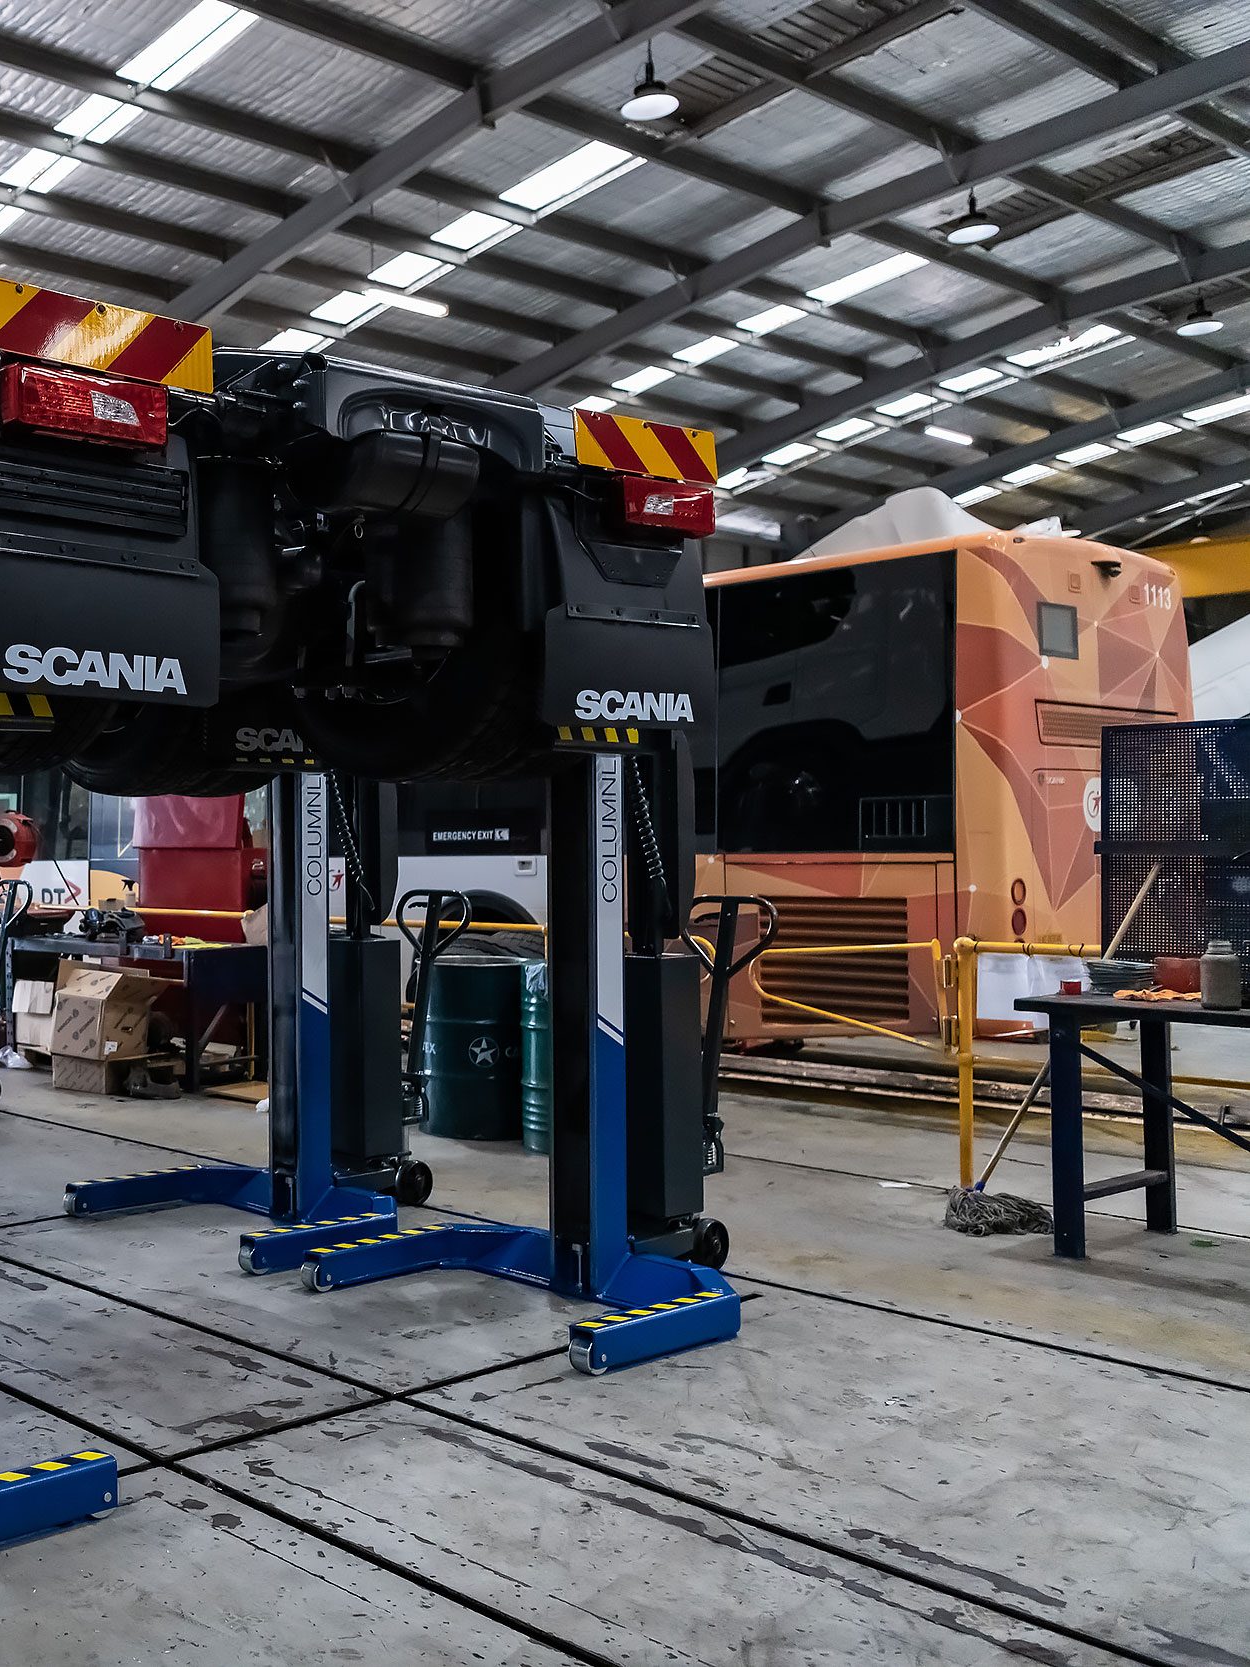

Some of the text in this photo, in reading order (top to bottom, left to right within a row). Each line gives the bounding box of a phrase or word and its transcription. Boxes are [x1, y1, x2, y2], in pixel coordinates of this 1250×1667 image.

[1144, 583, 1171, 610] 1113
[2, 644, 187, 695] SCANIA
[574, 689, 694, 722] SCANIA
[433, 830, 494, 841] EMERGENCY EXIT
